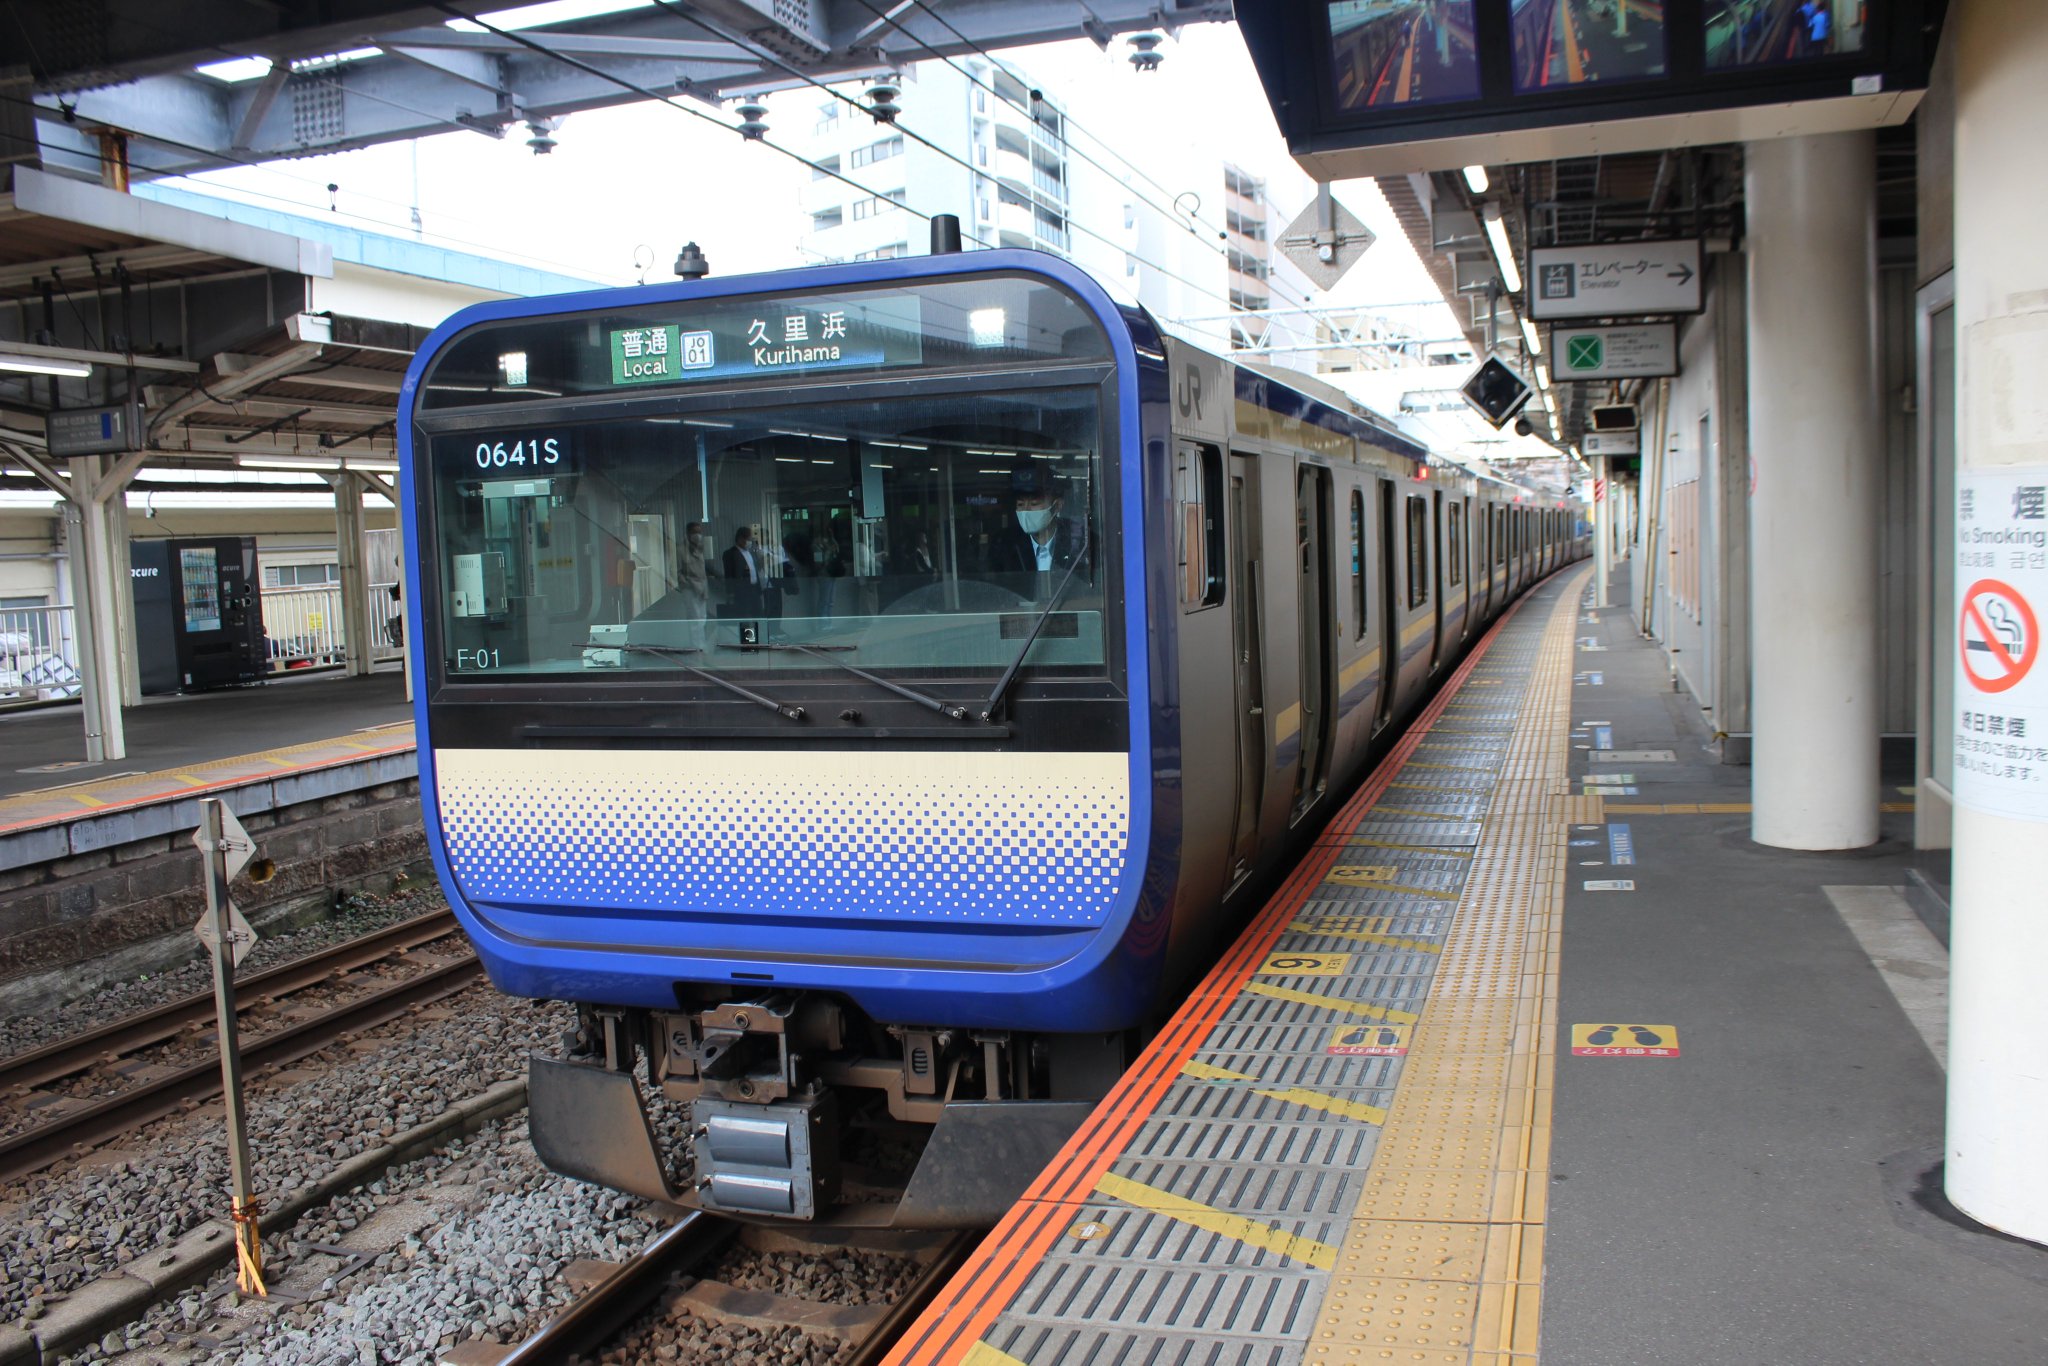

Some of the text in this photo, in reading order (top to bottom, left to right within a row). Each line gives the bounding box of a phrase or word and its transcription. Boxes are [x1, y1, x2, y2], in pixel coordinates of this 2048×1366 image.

[1580, 259, 1664, 278] エレベーター
[622, 311, 847, 358] 普通 久里浜
[690, 338, 706, 348] JO
[623, 345, 841, 378] Local Kurihama
[688, 349, 707, 363] 01
[1178, 362, 1203, 421] JR
[476, 438, 559, 468] 0641S
[1972, 527, 2046, 548] Smoking
[457, 648, 499, 668] F-01
[1334, 869, 1376, 877] 5
[1269, 957, 1322, 969] 6
